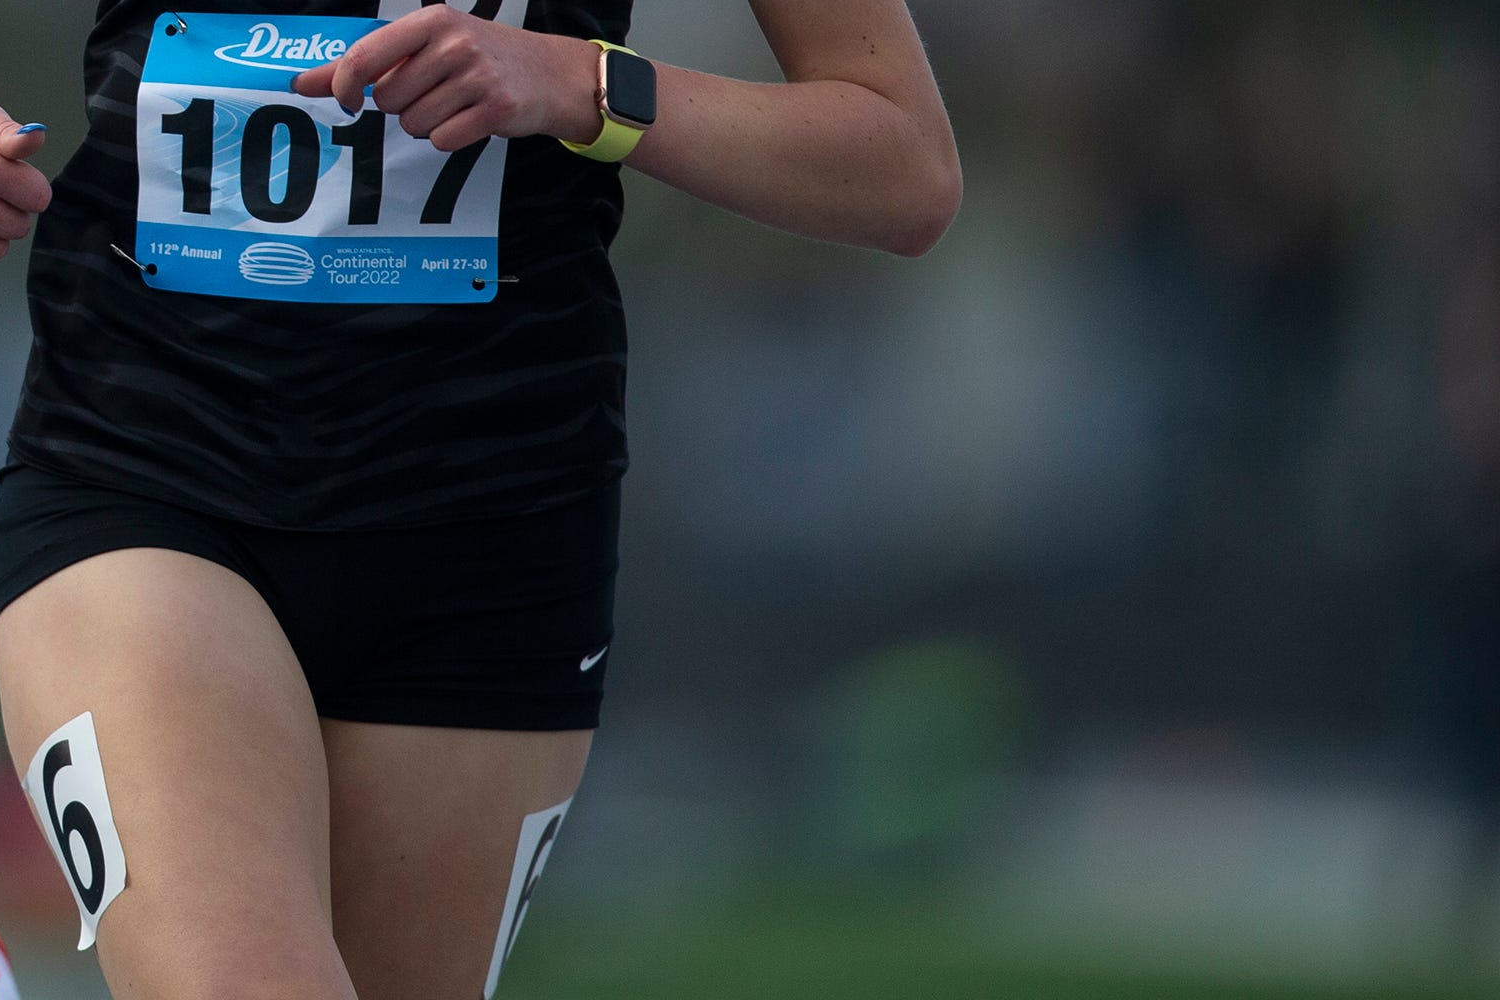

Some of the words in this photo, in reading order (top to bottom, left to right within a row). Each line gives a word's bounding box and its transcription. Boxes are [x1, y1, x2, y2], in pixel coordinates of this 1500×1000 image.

[240, 22, 346, 61] Drake
[161, 97, 493, 226] 1017
[181, 245, 222, 260] Annual
[320, 254, 407, 269] Continental
[421, 258, 449, 272] April
[452, 258, 488, 271] 27-30
[42, 738, 106, 916] 6
